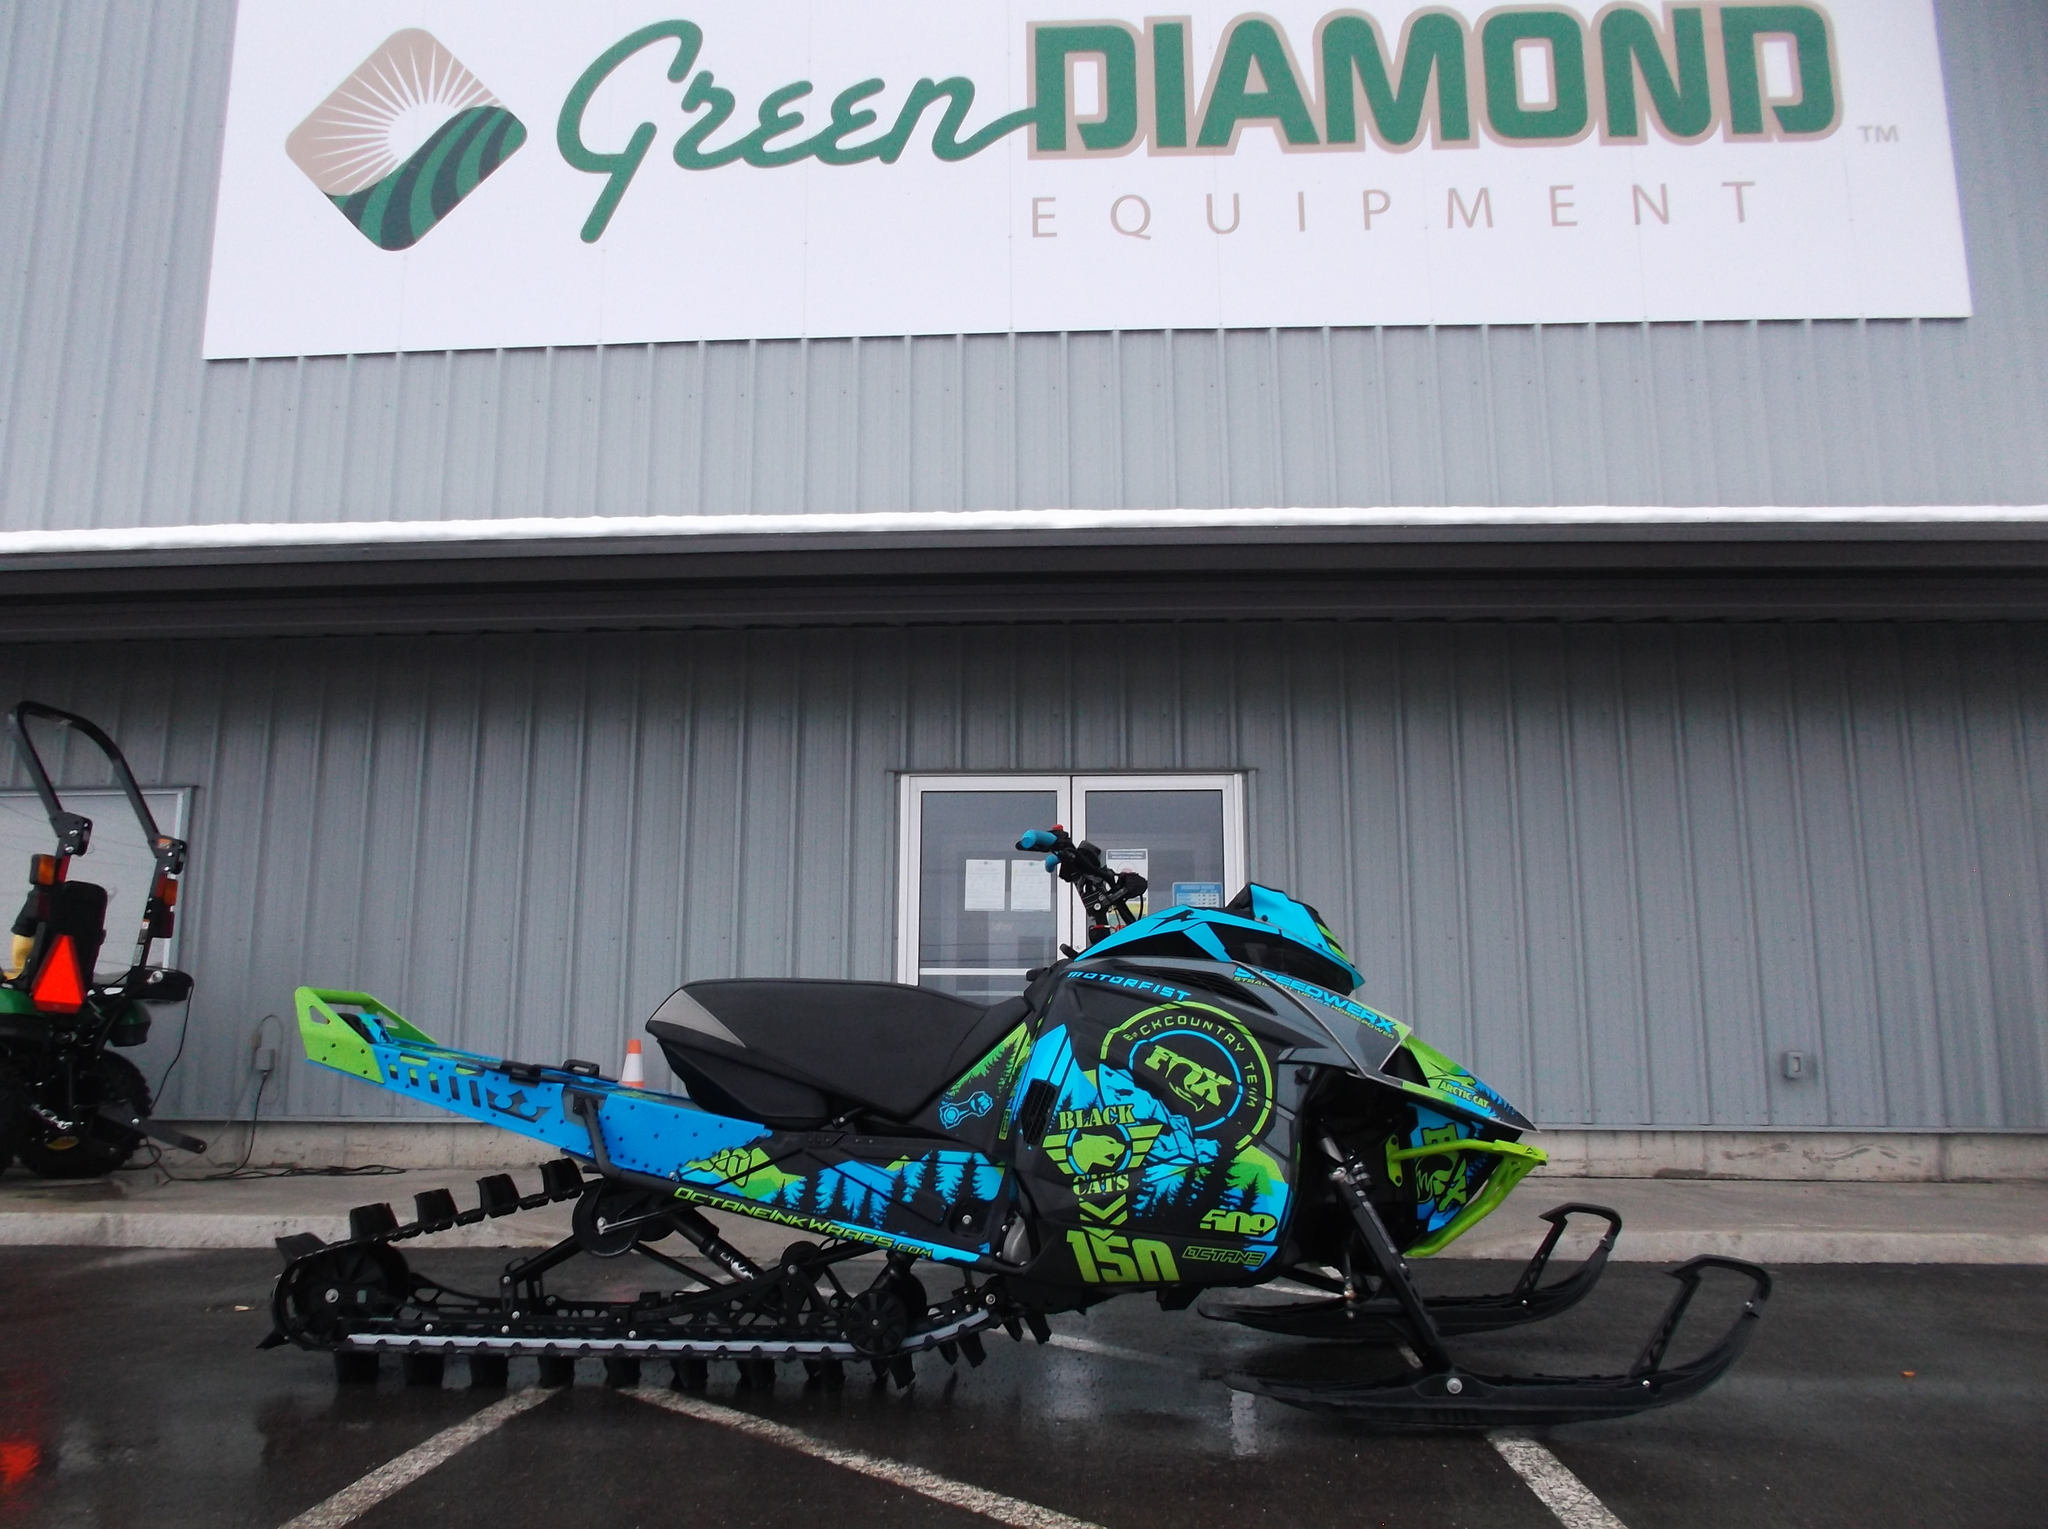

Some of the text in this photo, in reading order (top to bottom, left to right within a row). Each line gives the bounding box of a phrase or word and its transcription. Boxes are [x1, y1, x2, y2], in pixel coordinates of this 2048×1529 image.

[556, 20, 1036, 244] Green
[1026, 0, 1845, 160] DIAMOND
[1031, 181, 1756, 241] EQUIPMENT
[1067, 971, 1192, 1001] MOTORFIST
[1233, 966, 1396, 1034] SPEEDWERX
[1144, 1044, 1233, 1112] FOX
[1439, 1080, 1490, 1109] ARCTIC CAT
[1058, 1104, 1136, 1130] BLACK
[1072, 1172, 1130, 1196] CATS
[1200, 1208, 1277, 1236] 509
[1066, 1229, 1181, 1283] 150
[1181, 1245, 1266, 1267] OCTANE
